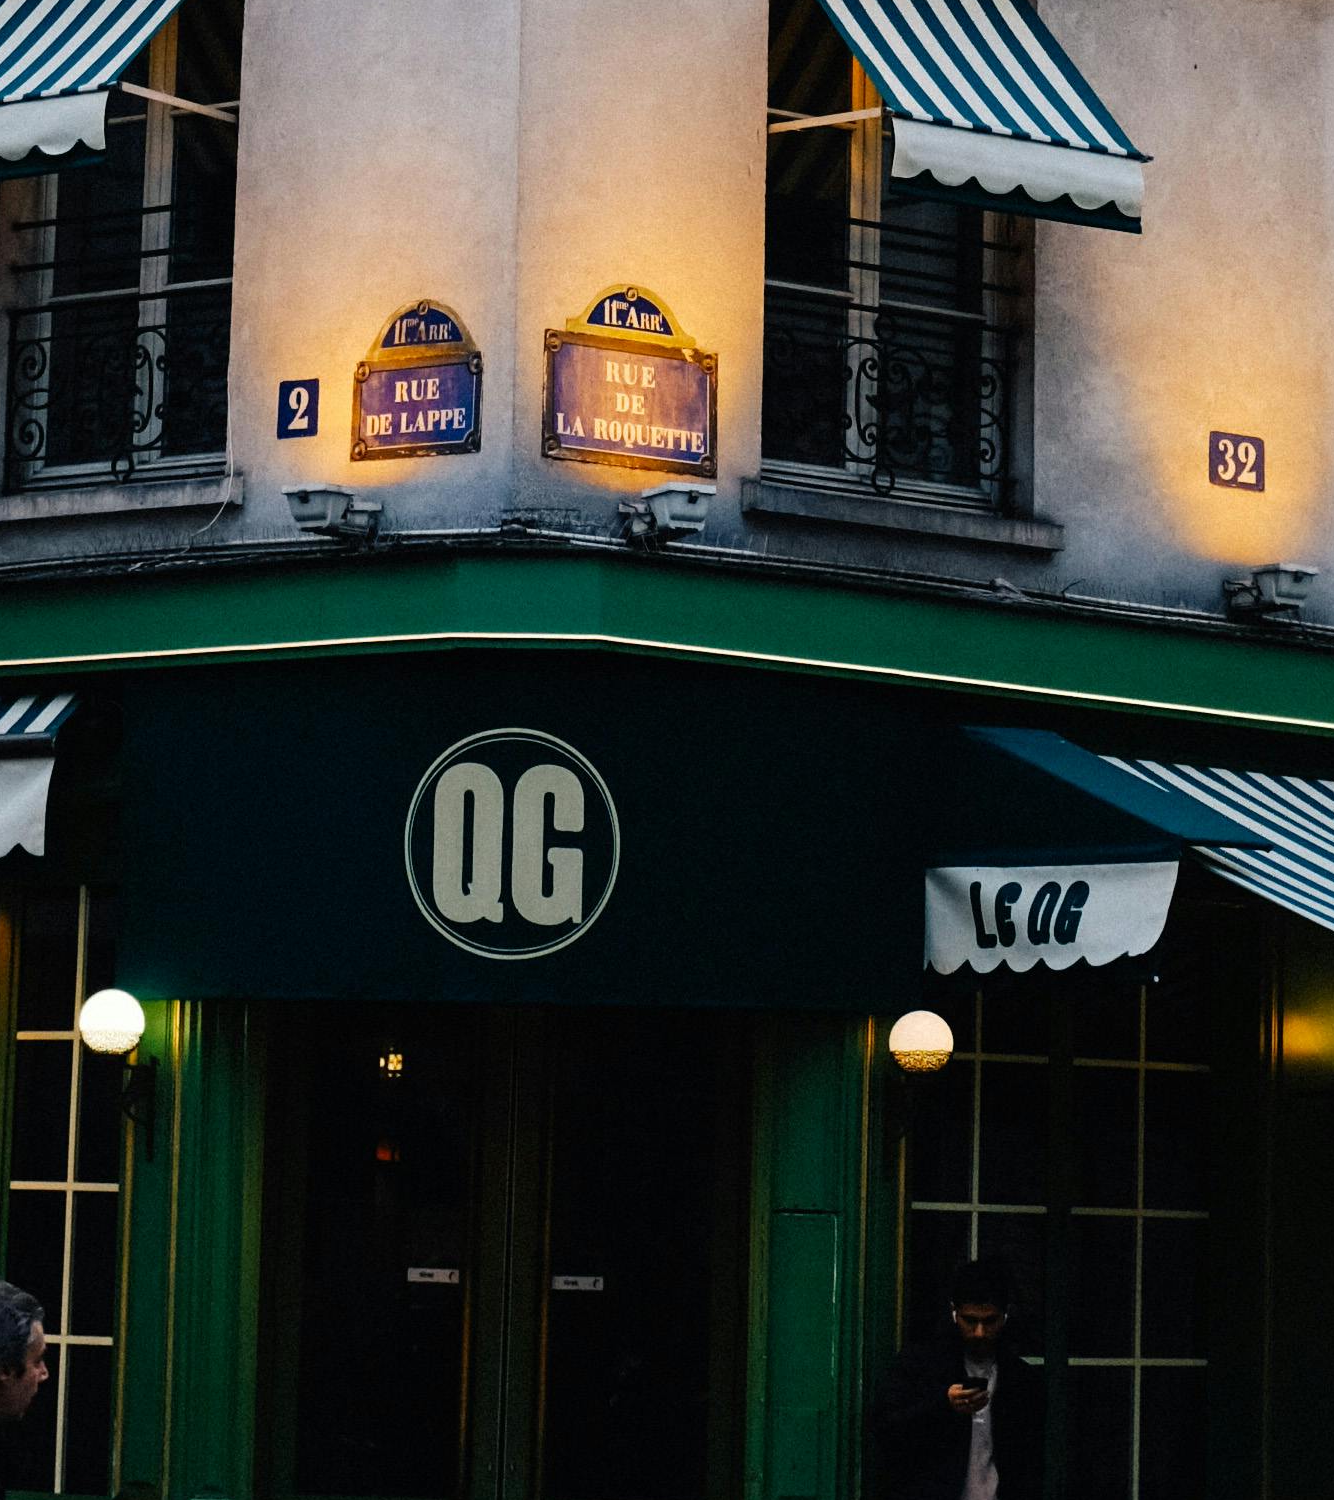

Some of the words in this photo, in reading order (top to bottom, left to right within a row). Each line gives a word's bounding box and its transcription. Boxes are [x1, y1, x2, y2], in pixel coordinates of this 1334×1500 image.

[394, 378, 440, 403] RUE
[605, 361, 656, 389] RUE
[288, 386, 310, 430] 2
[366, 413, 392, 437] DE
[400, 408, 466, 434] LAPPE
[615, 392, 646, 415] DE
[556, 412, 586, 438] LA
[593, 418, 705, 454] ROQUETTE
[1217, 439, 1257, 485] 32
[432, 762, 586, 926] QG
[969, 881, 1023, 949] LE
[1027, 880, 1090, 946] QG
